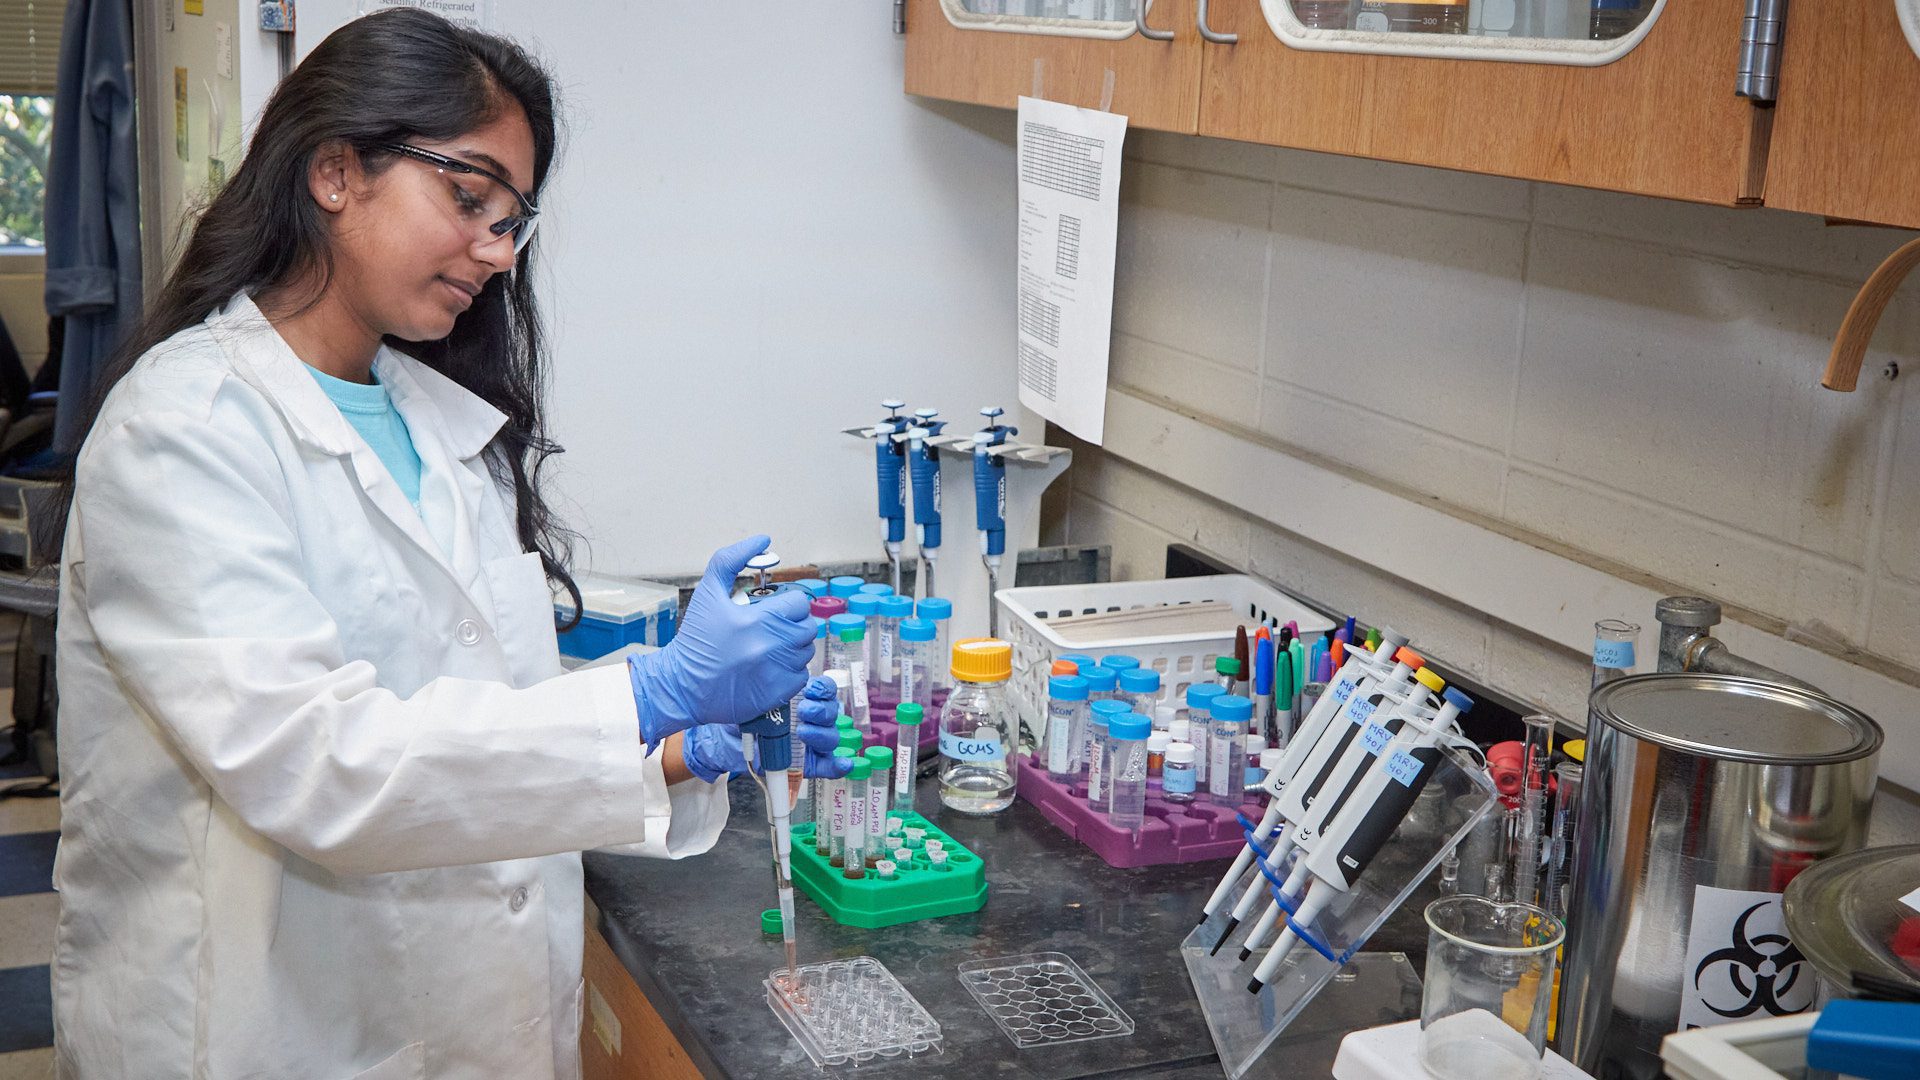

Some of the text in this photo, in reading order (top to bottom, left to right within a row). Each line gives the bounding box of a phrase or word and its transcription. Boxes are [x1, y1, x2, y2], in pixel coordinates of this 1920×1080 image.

[419, 0, 476, 12] Refrigerated
[1423, 17, 1438, 25] 300
[1368, 724, 1392, 741] MRV
[957, 741, 995, 755] GCMS
[1365, 735, 1382, 752] 401
[1392, 752, 1417, 770] MRV
[1385, 763, 1407, 780] 401
[834, 813, 844, 831] PCA
